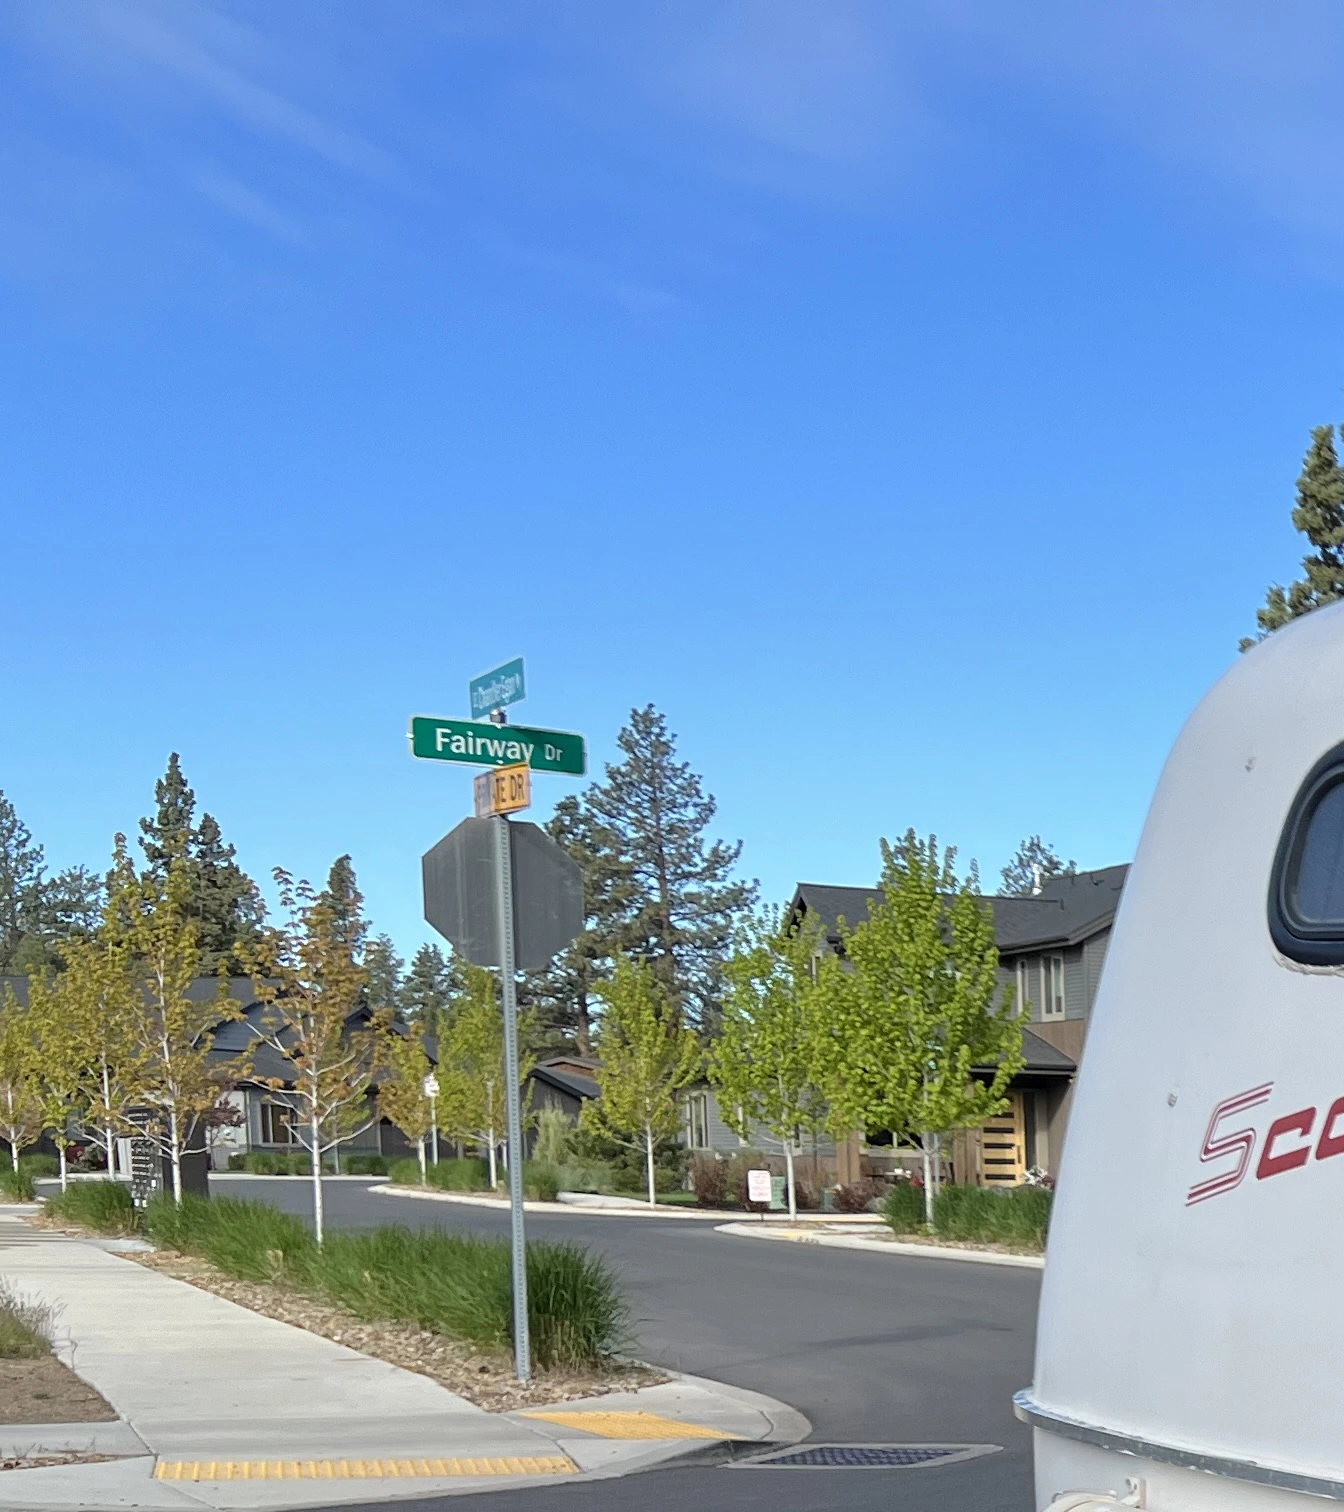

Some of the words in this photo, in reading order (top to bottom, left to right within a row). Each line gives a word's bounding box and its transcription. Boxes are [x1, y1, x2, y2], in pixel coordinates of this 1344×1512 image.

[436, 728, 534, 764] Fairway
[545, 744, 563, 761] Dr
[510, 773, 526, 801] DR
